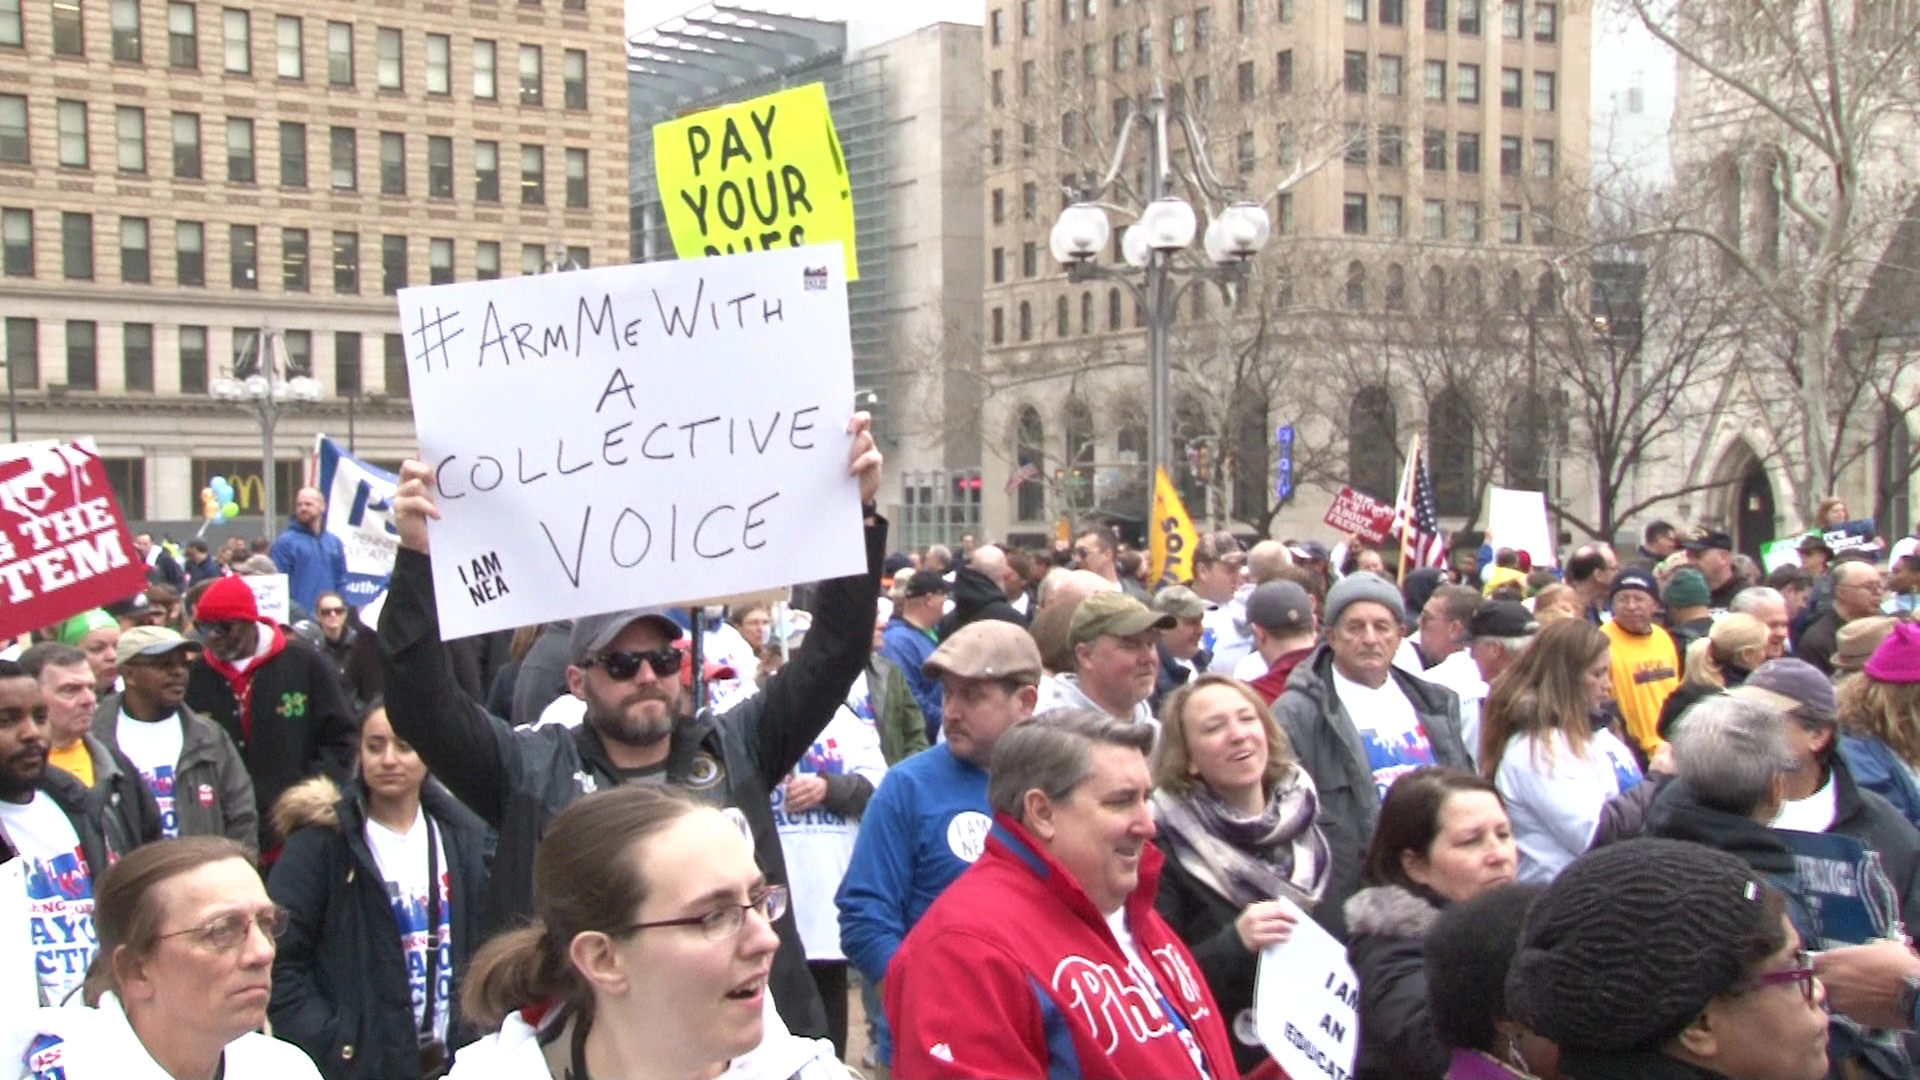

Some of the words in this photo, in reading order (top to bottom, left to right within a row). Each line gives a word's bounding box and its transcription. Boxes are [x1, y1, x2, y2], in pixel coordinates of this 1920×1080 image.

[687, 105, 776, 177] PAY
[680, 164, 814, 238] YOUR
[594, 367, 638, 413] A
[436, 406, 820, 500] COLLECTIVE
[17, 497, 117, 551] THE
[539, 492, 781, 588] VOICE
[0, 529, 130, 604] TEM
[458, 565, 469, 586] I
[473, 551, 503, 577] AM
[468, 575, 510, 607] NEA
[961, 839, 983, 857] NE
[967, 818, 988, 836] AM
[1324, 970, 1336, 990] I
[1333, 980, 1359, 1010] AM
[1318, 1012, 1346, 1044] AN
